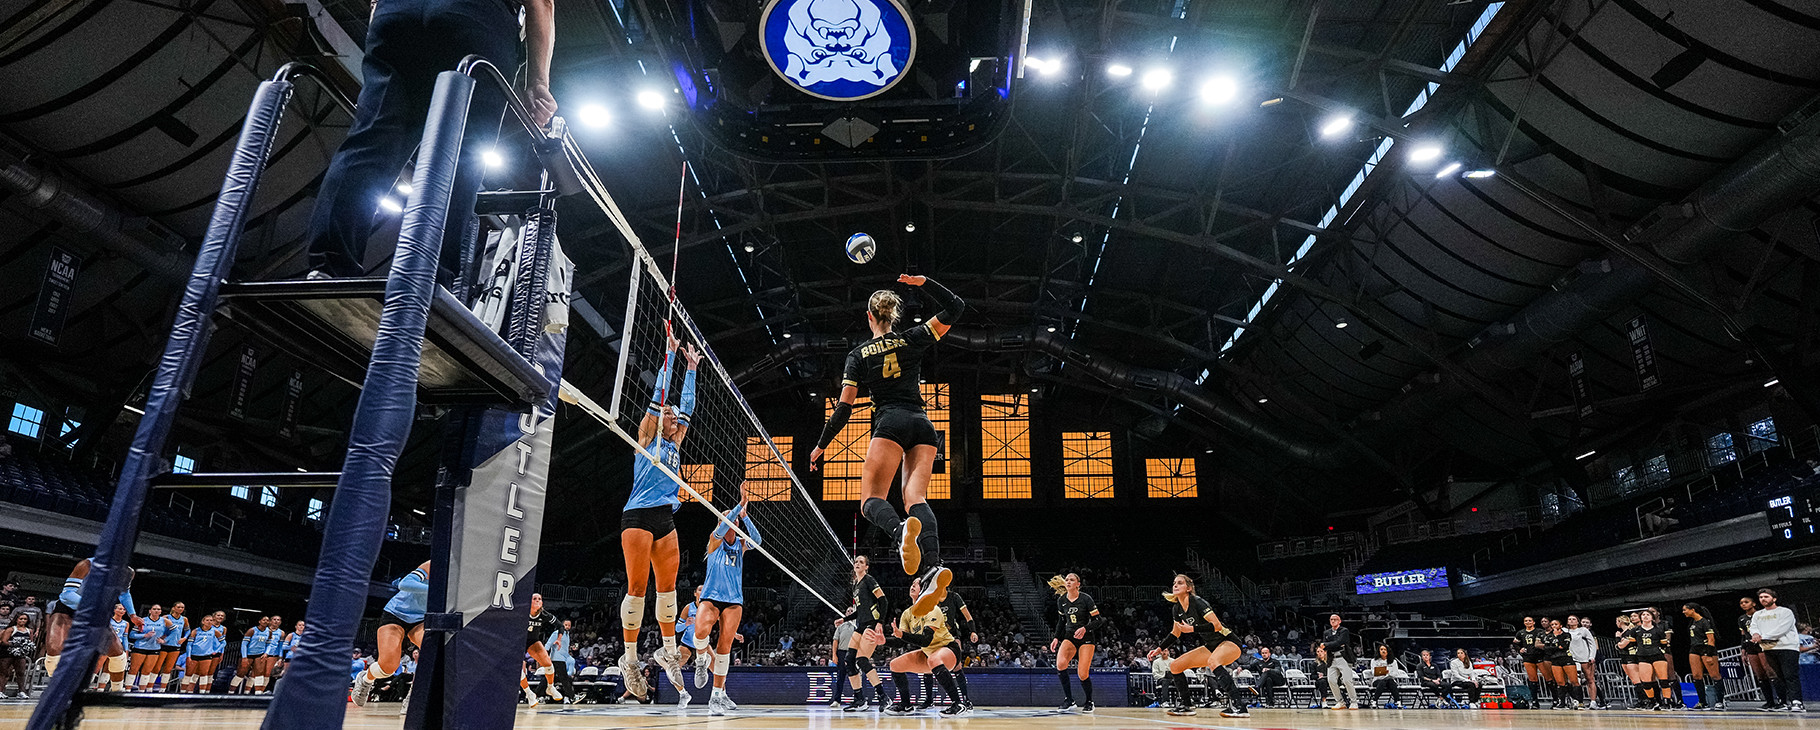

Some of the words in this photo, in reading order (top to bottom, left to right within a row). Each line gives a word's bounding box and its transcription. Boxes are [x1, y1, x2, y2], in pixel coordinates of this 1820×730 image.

[50, 259, 75, 280] NCAA
[882, 353, 901, 378] 4
[491, 362, 546, 610] UTLER
[1769, 496, 1792, 508] BUTLER
[1784, 506, 1793, 517] 7
[1784, 528, 1791, 539] 0
[724, 554, 737, 567] 17
[1374, 573, 1427, 587] BUTLER
[1070, 614, 1077, 624] 6
